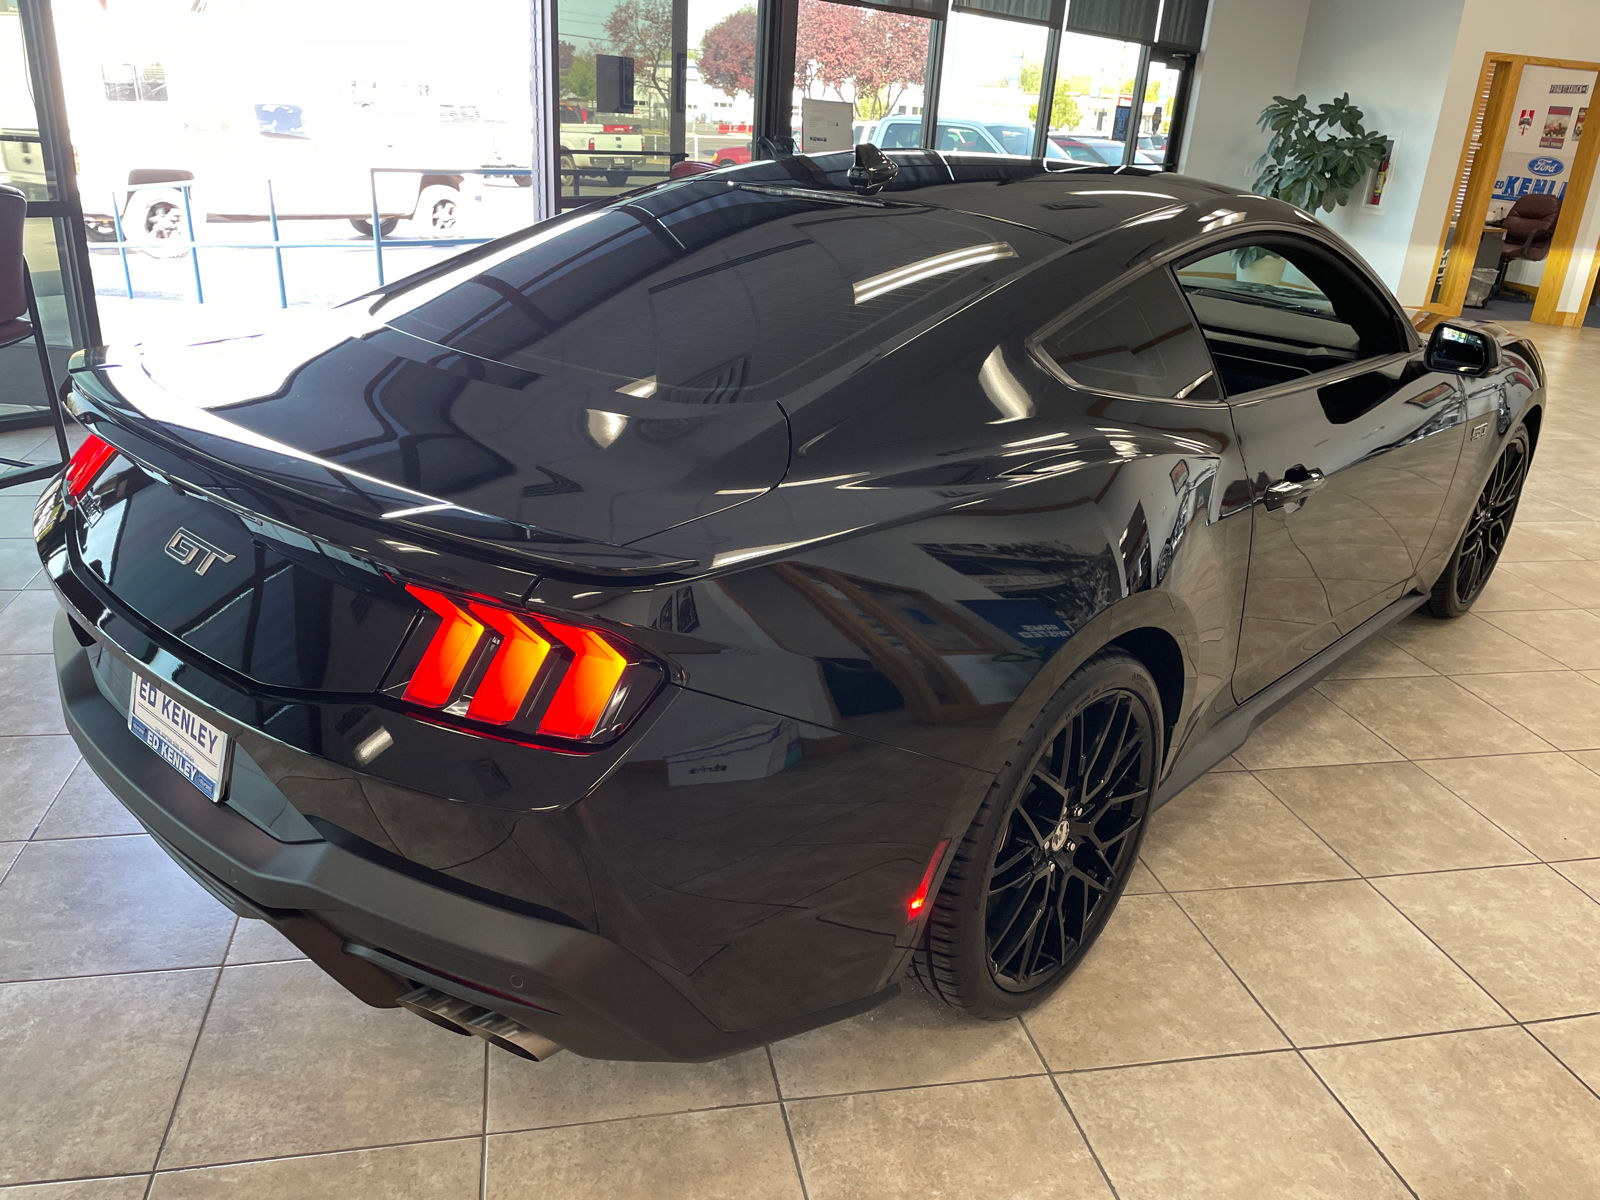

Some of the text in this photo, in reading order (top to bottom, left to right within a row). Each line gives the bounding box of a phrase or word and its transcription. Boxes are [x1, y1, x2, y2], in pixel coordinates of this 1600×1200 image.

[1494, 180, 1504, 189] ED
[1534, 159, 1557, 172] Ford
[164, 526, 236, 576] GT
[139, 681, 218, 754] ED KENLEY
[146, 731, 197, 782] ED KENLEY
